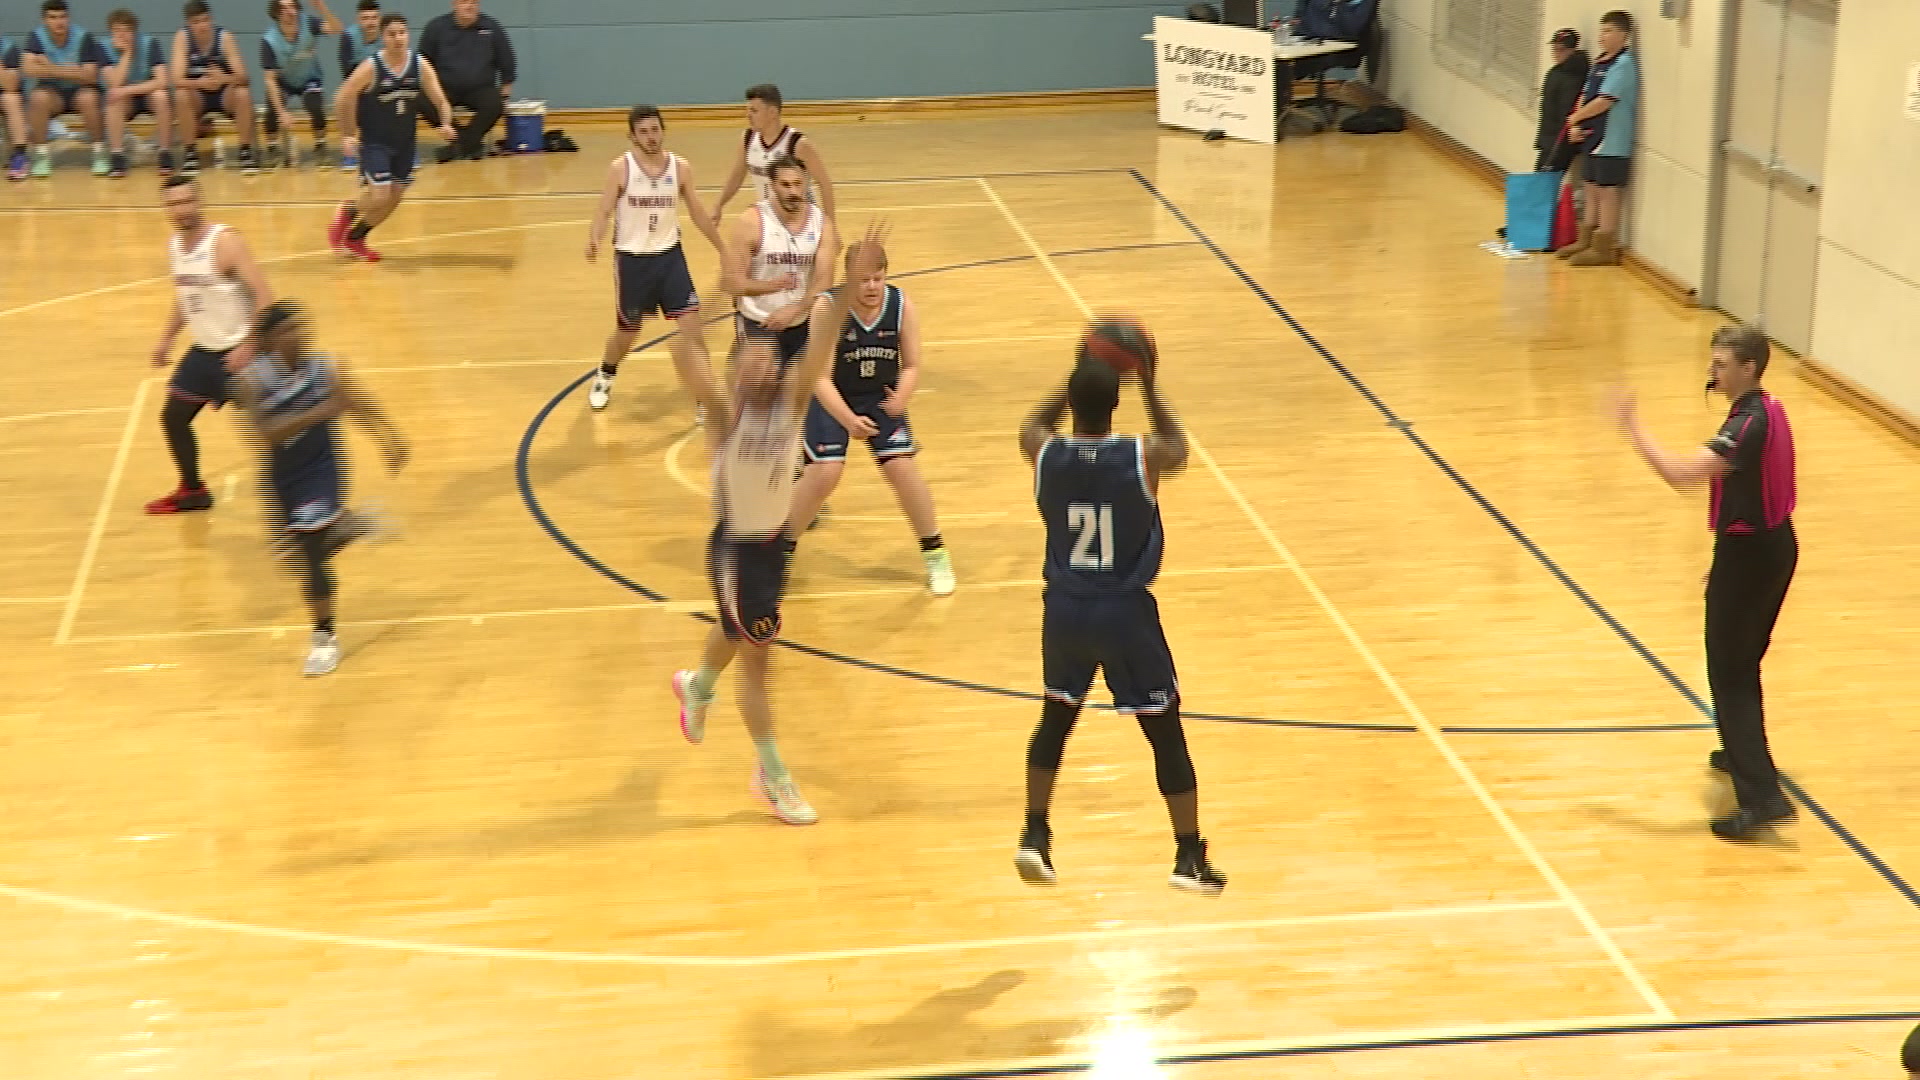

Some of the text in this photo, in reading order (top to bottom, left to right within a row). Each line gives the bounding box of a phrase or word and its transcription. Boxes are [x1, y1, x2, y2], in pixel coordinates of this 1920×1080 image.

[1163, 44, 1266, 76] LONGYARD
[1192, 71, 1238, 91] HOTEL
[648, 213, 658, 233] 2
[859, 360, 876, 379] 18
[1067, 502, 1115, 571] 21
